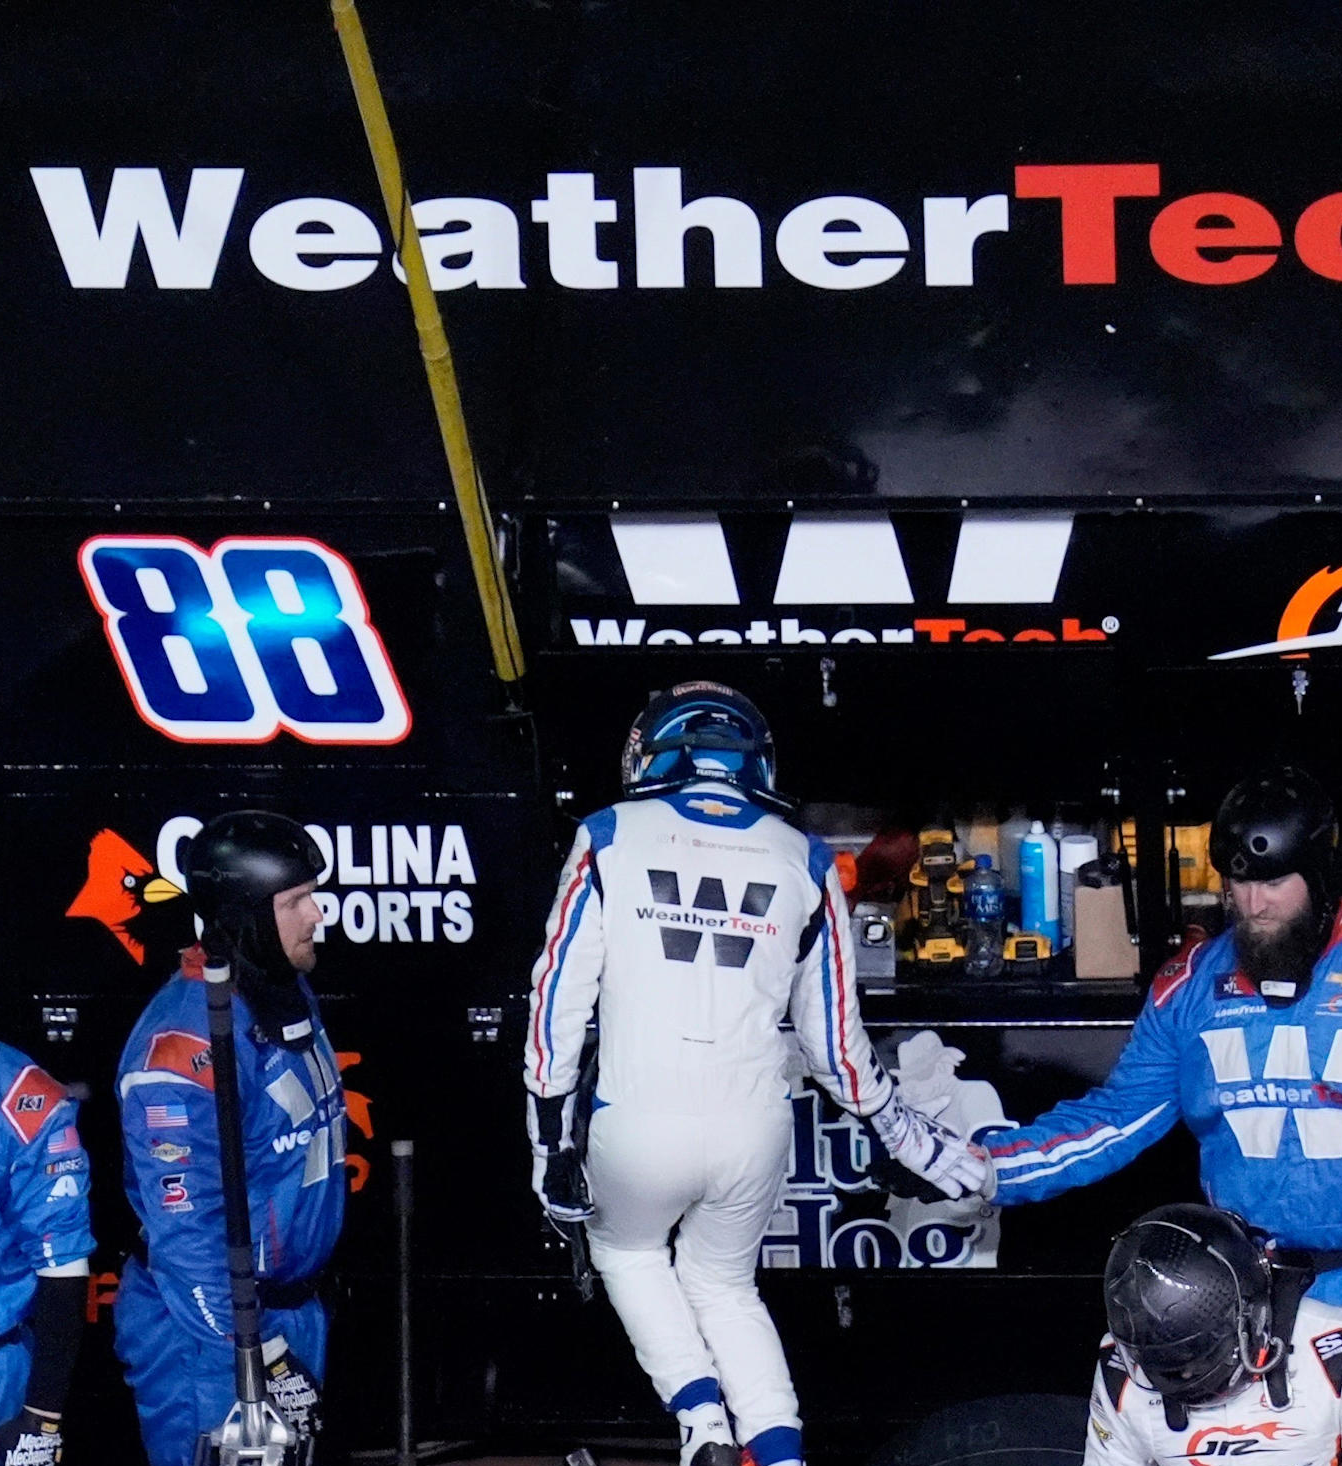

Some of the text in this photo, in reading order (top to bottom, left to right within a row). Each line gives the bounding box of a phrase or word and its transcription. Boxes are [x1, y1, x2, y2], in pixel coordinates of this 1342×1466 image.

[78, 534, 412, 745] 88
[157, 816, 477, 893] COLINA
[636, 906, 781, 937] WeatherTech
